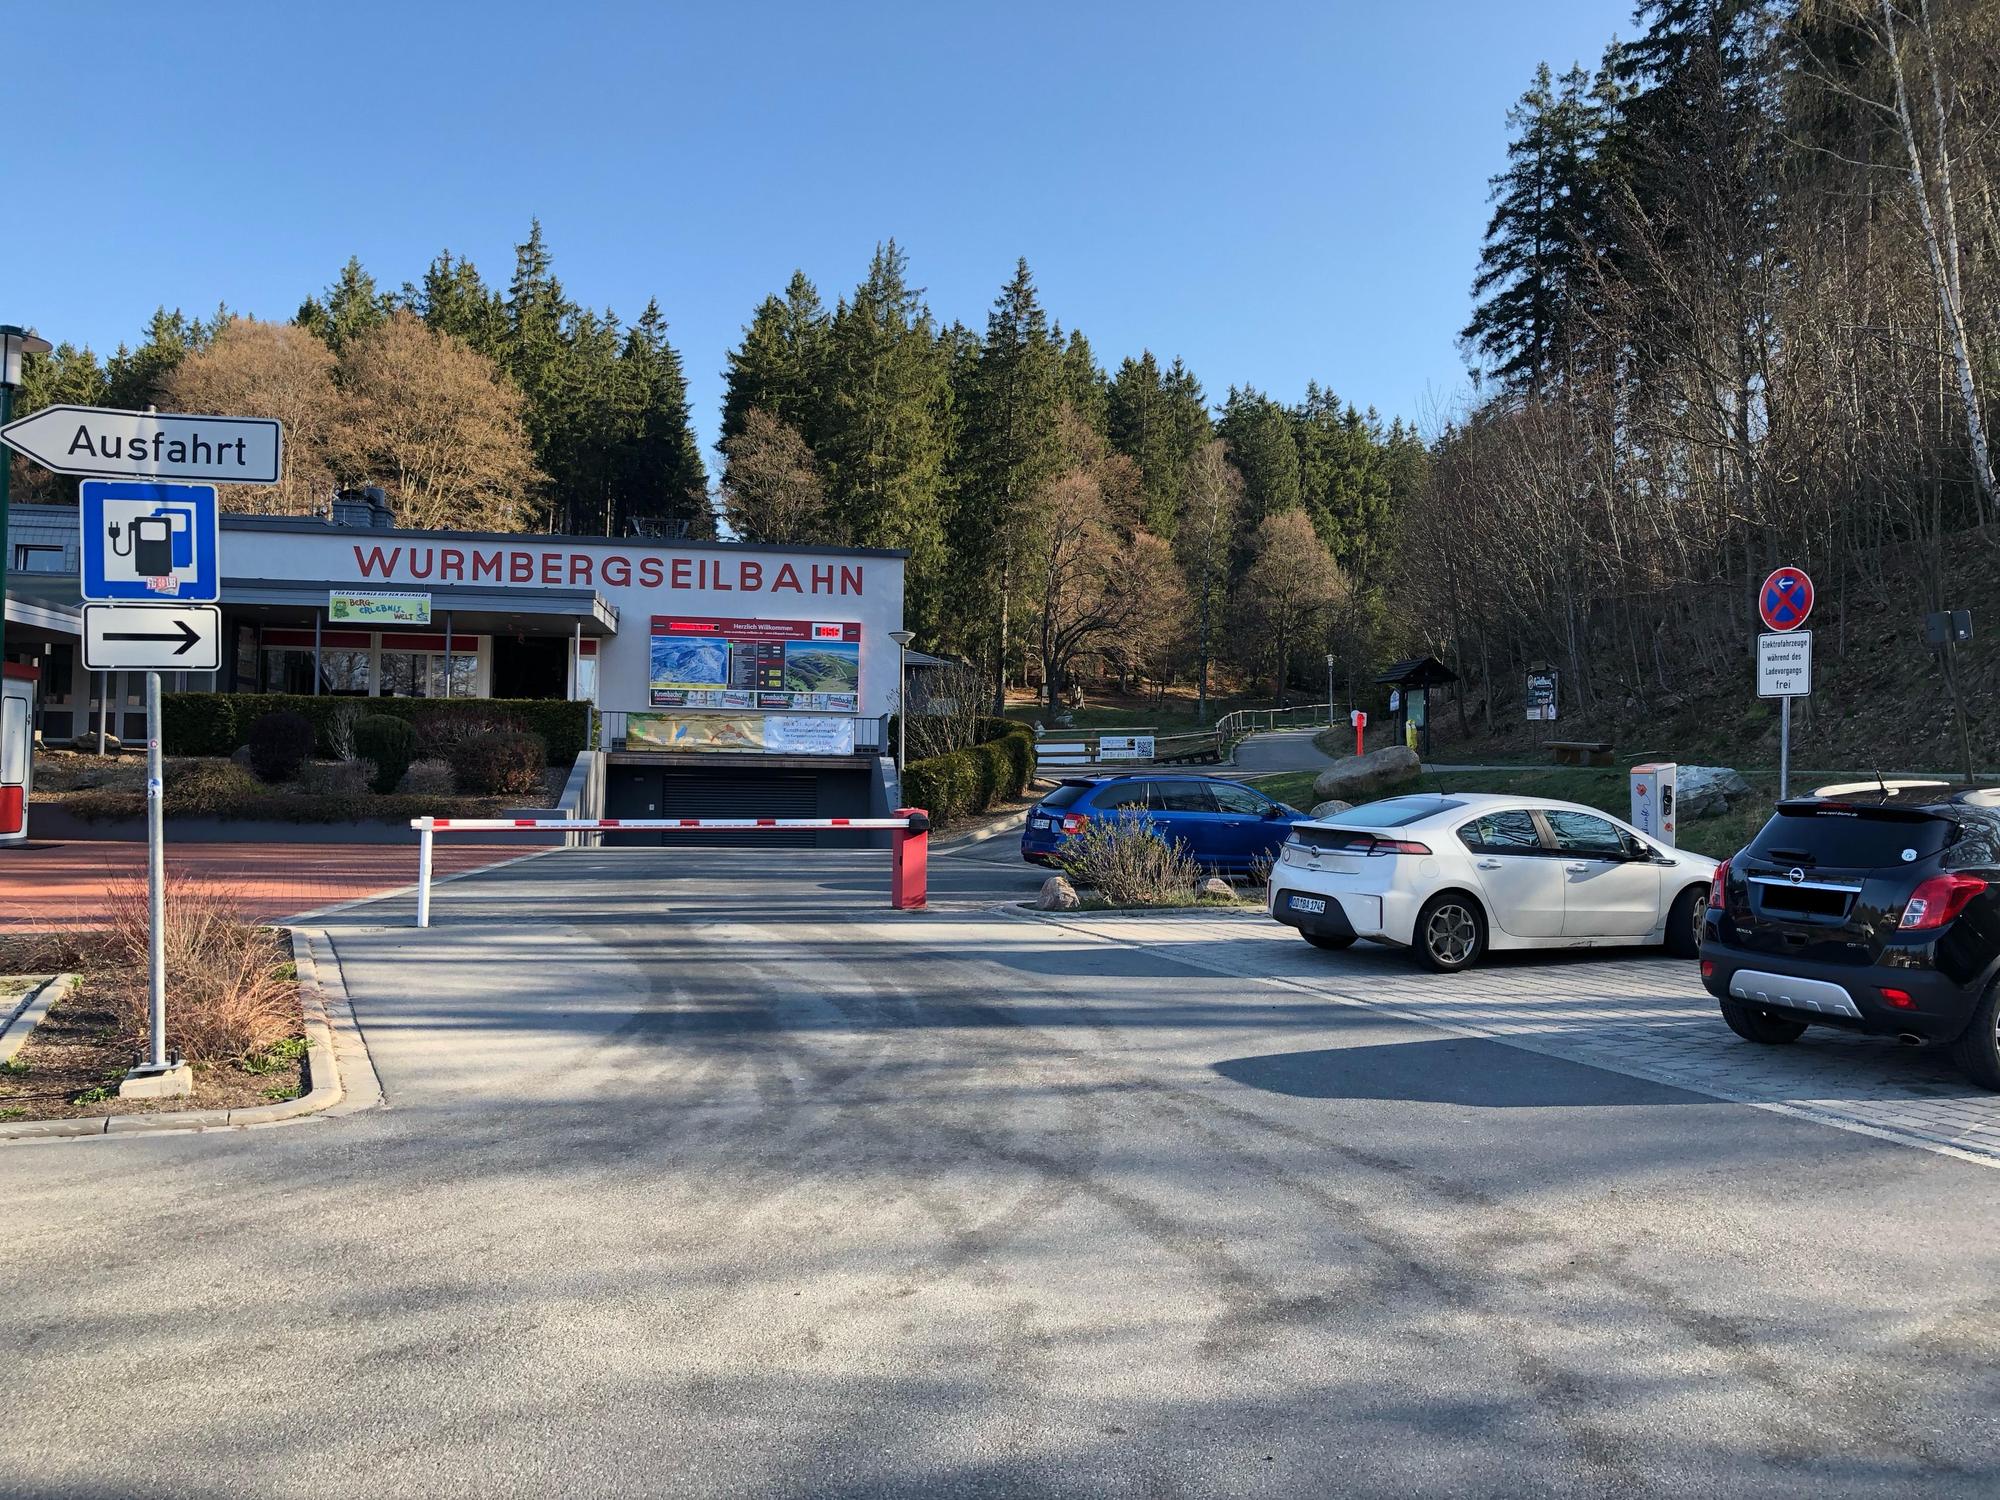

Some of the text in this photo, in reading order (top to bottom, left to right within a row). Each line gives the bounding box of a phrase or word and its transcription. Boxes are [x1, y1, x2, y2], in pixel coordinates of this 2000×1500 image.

[67, 424, 247, 466] Ausfahrt
[353, 545, 864, 596] WURMBERGSEILBAHN
[1762, 639, 1808, 649] Elektrofahrzeuge
[1767, 652, 1802, 662] während des
[1765, 667, 1802, 676] Ladevorgangs
[1776, 680, 1791, 689] frei
